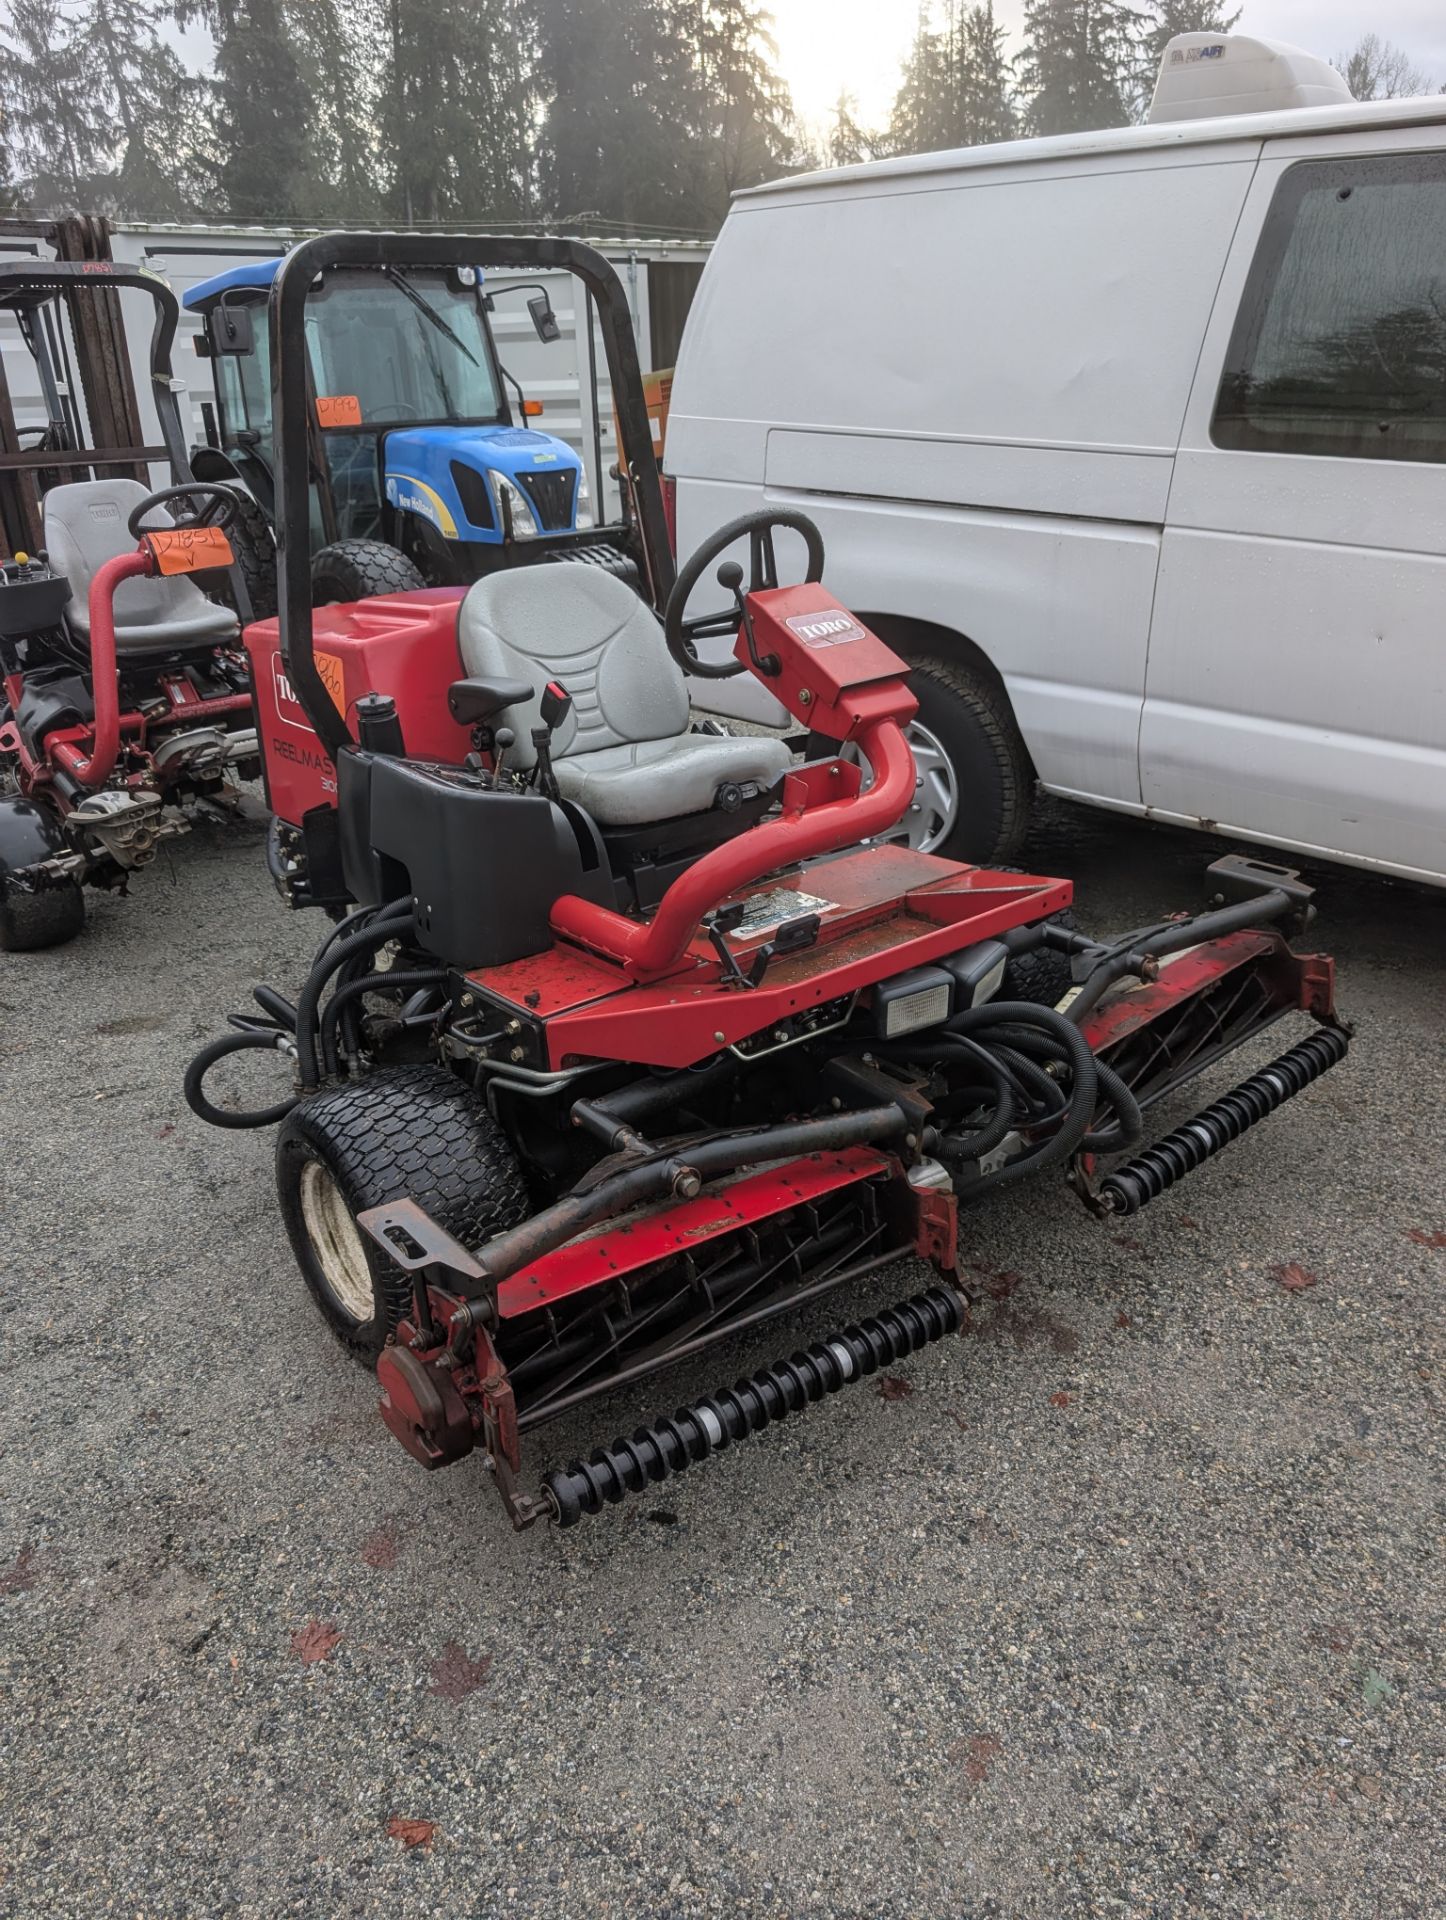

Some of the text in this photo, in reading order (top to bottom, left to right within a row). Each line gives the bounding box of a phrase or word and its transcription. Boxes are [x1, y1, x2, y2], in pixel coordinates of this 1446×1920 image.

[399, 493, 434, 520] New Holland
[798, 619, 852, 639] TORO
